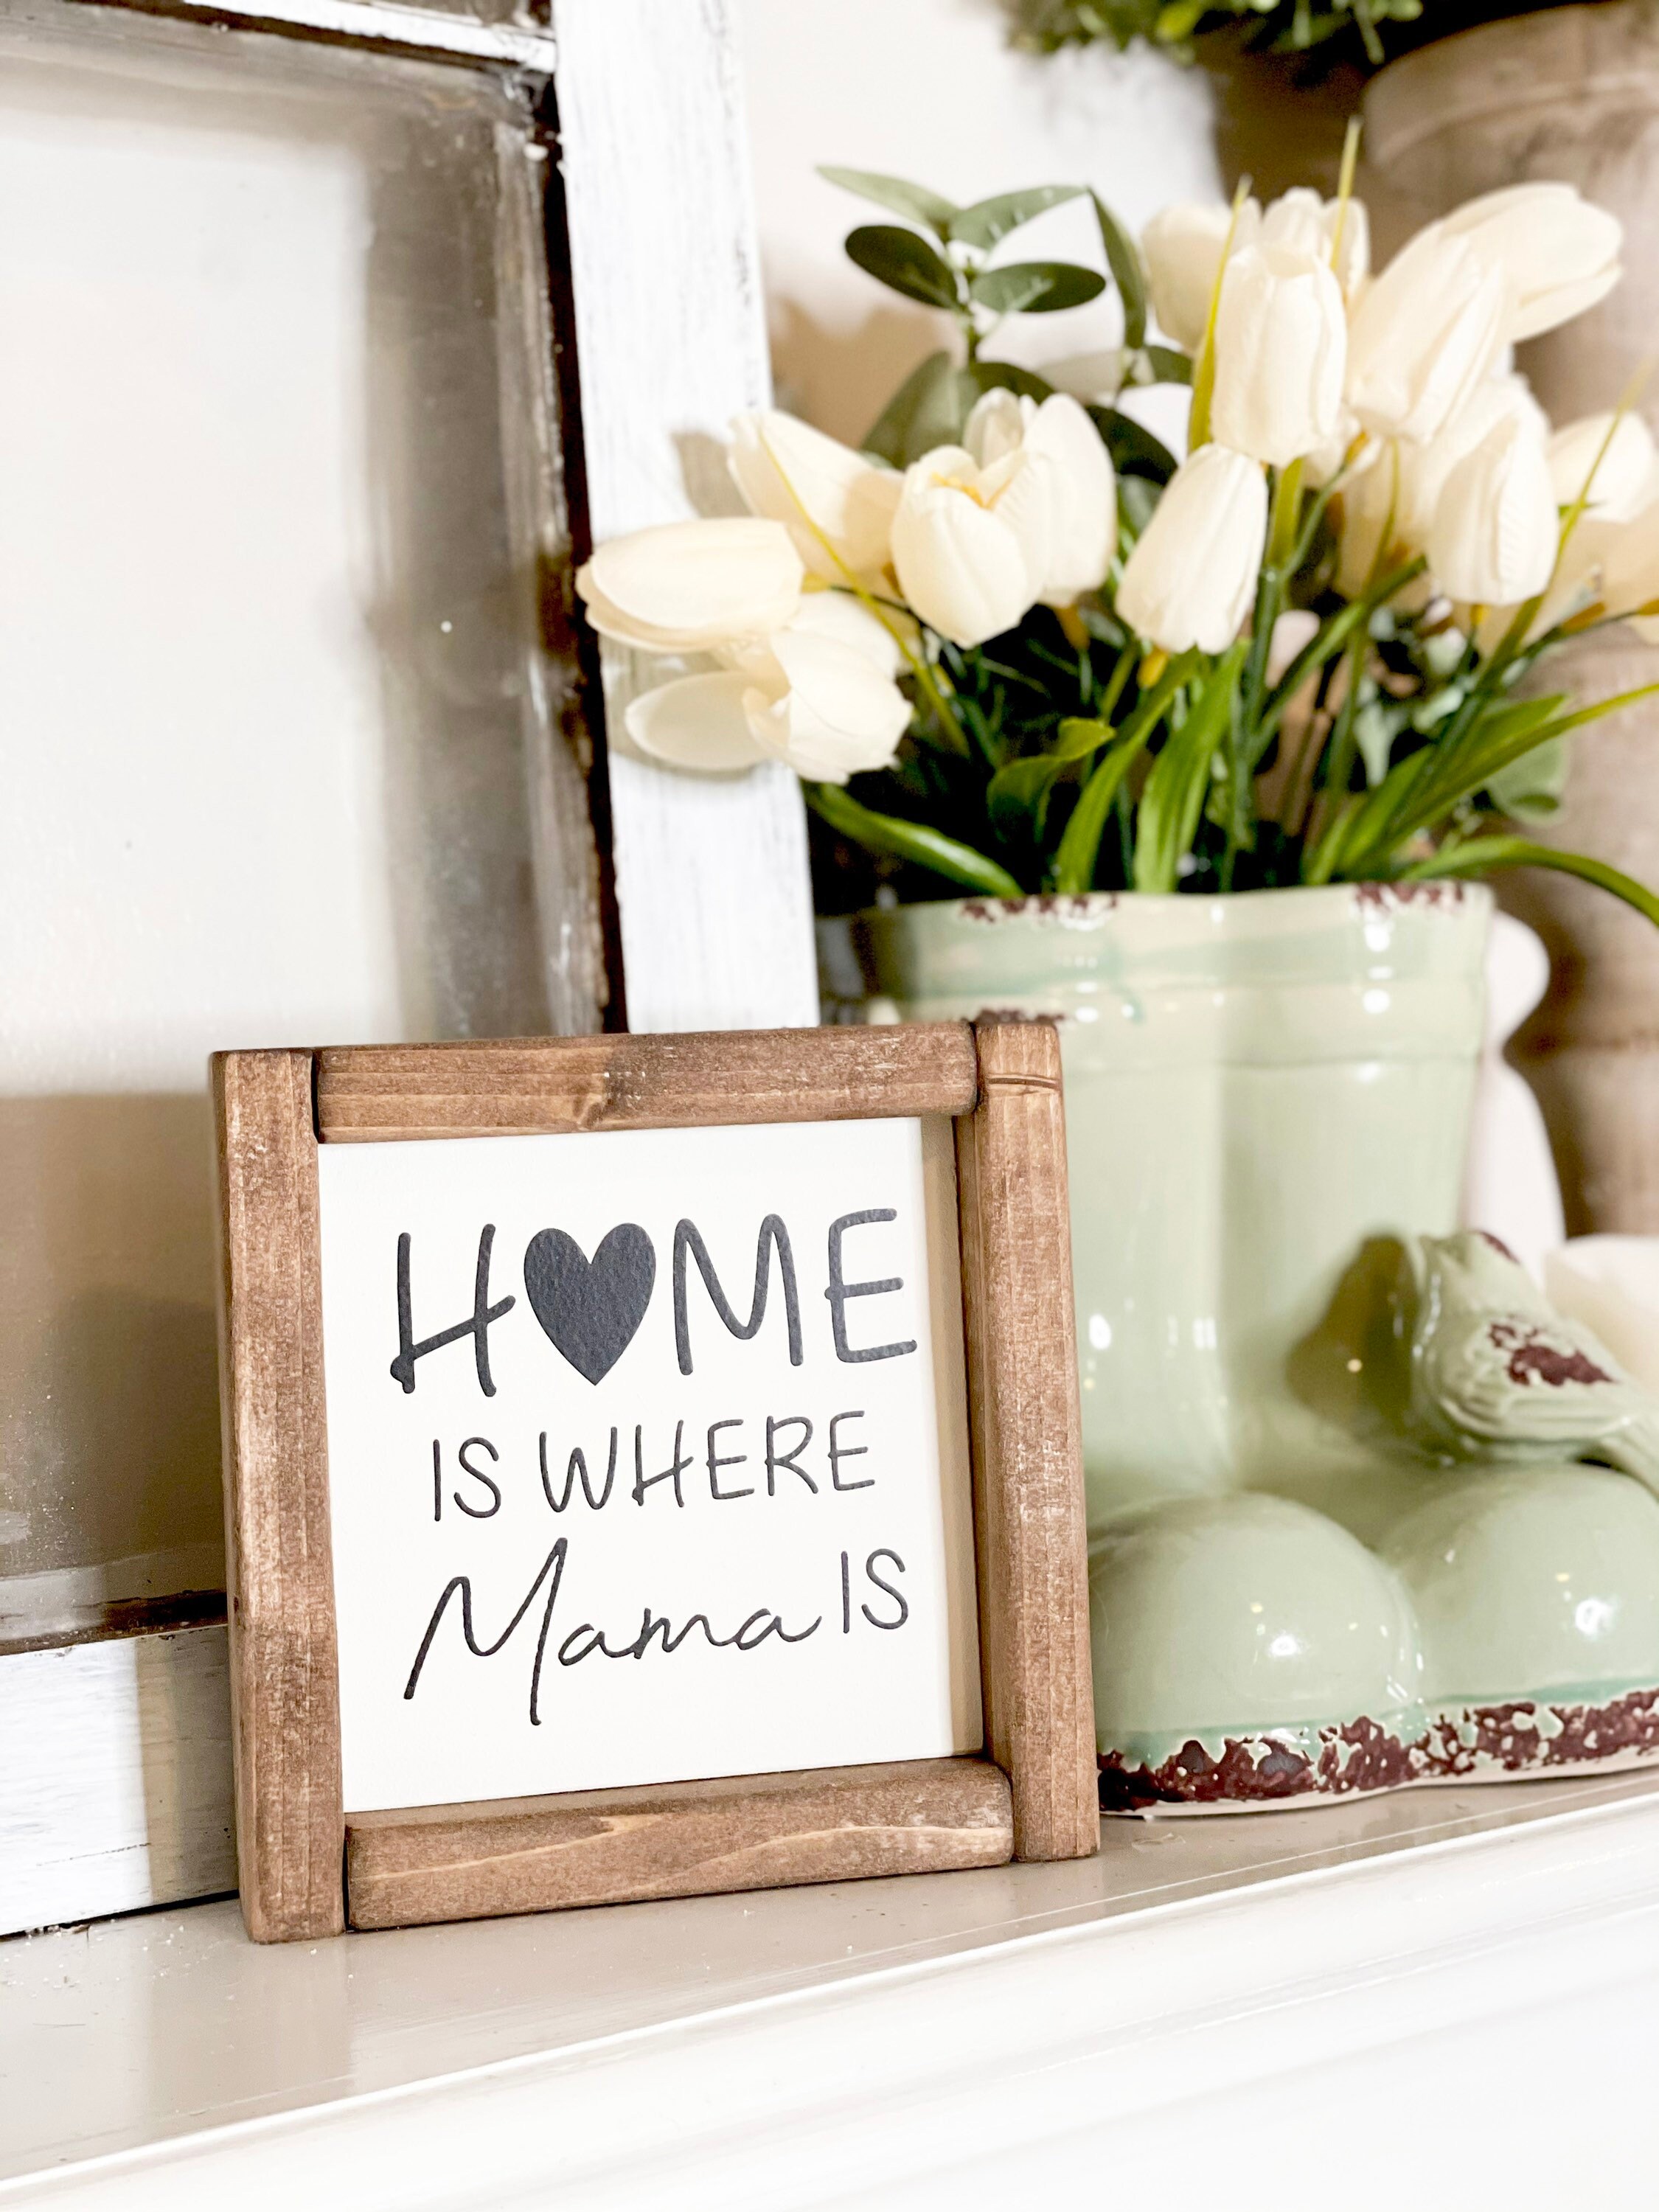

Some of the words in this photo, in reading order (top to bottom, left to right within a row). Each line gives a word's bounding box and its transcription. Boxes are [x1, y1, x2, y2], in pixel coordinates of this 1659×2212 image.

[433, 1436, 502, 1522] IS
[538, 1410, 876, 1514] WHERE
[403, 1537, 823, 1727] Mama
[841, 1548, 909, 1635] IS
